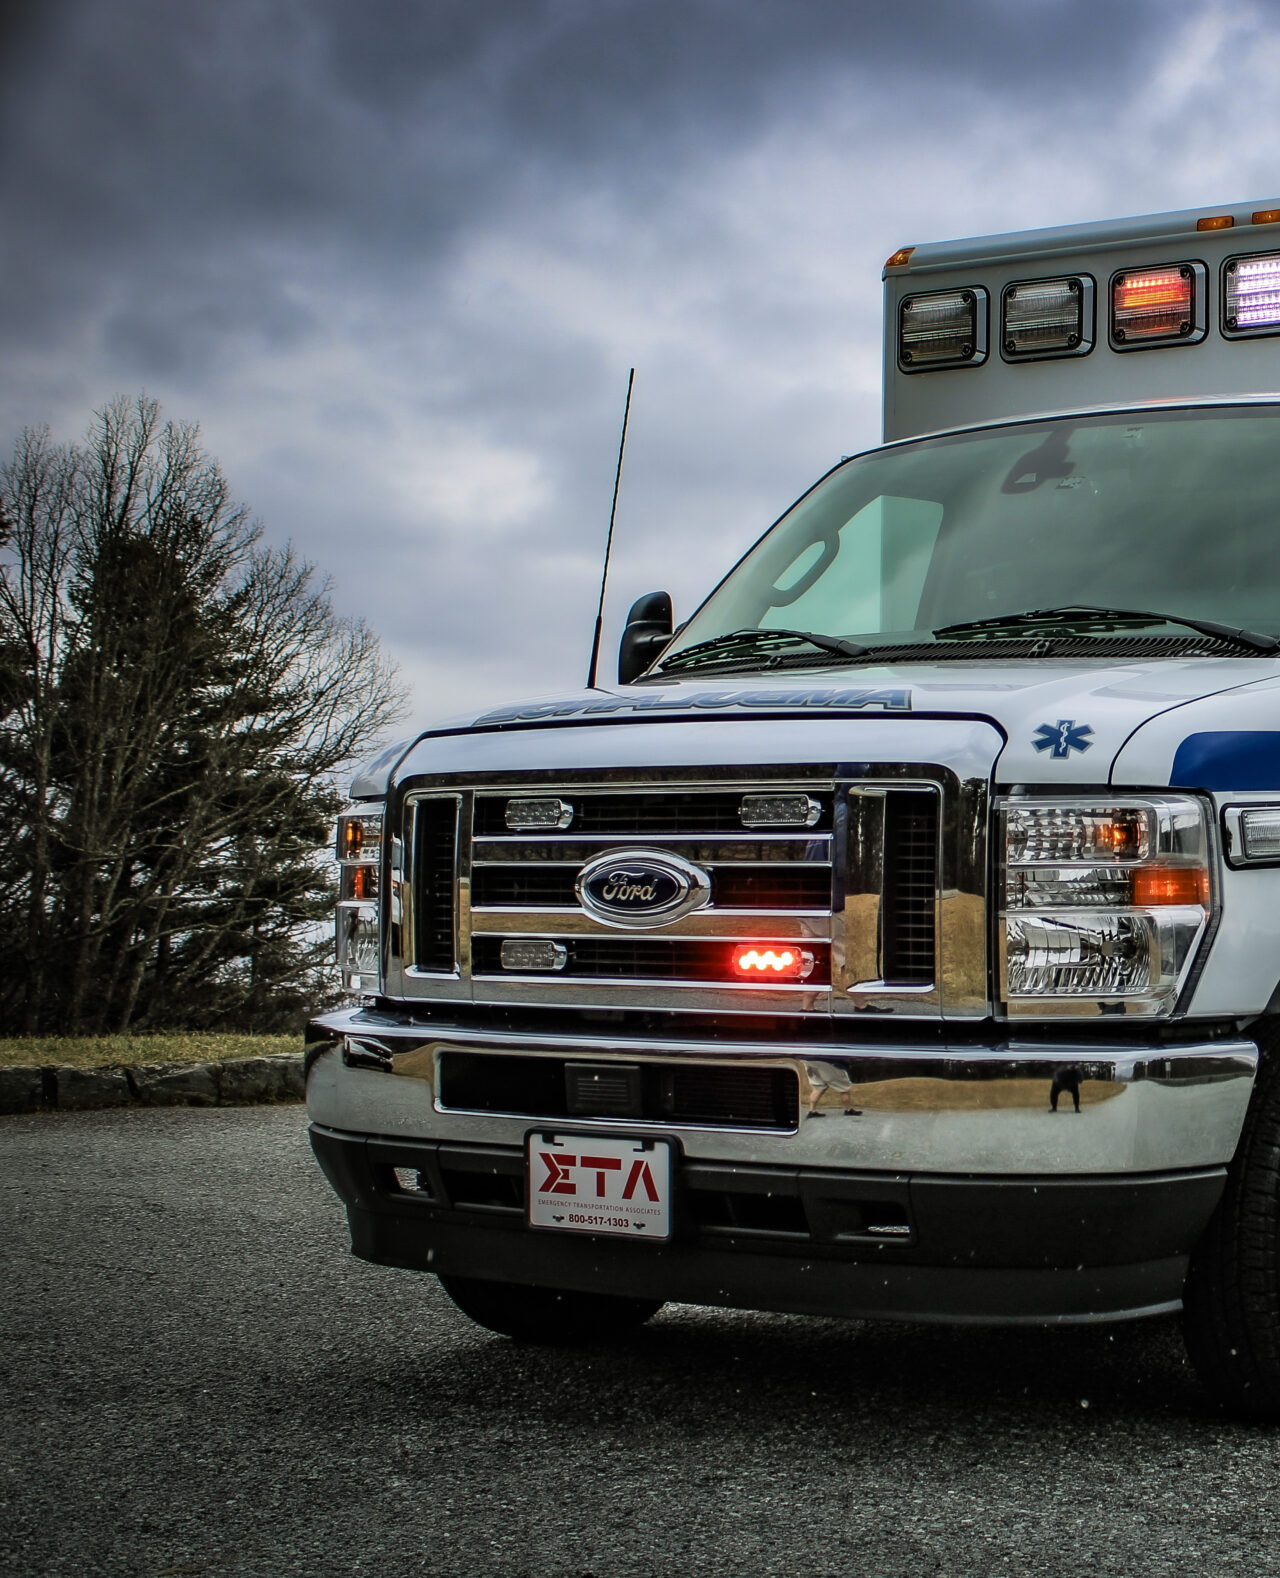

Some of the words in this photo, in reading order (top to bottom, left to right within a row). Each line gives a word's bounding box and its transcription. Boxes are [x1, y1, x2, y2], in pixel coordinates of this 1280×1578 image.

[602, 870, 659, 901] Ford
[538, 1199, 572, 1208] EMERGENCY
[573, 1202, 624, 1212] TRANSPORTATION
[625, 1206, 661, 1216] ASSOCIATES
[568, 1213, 630, 1228] 800-517-1303
